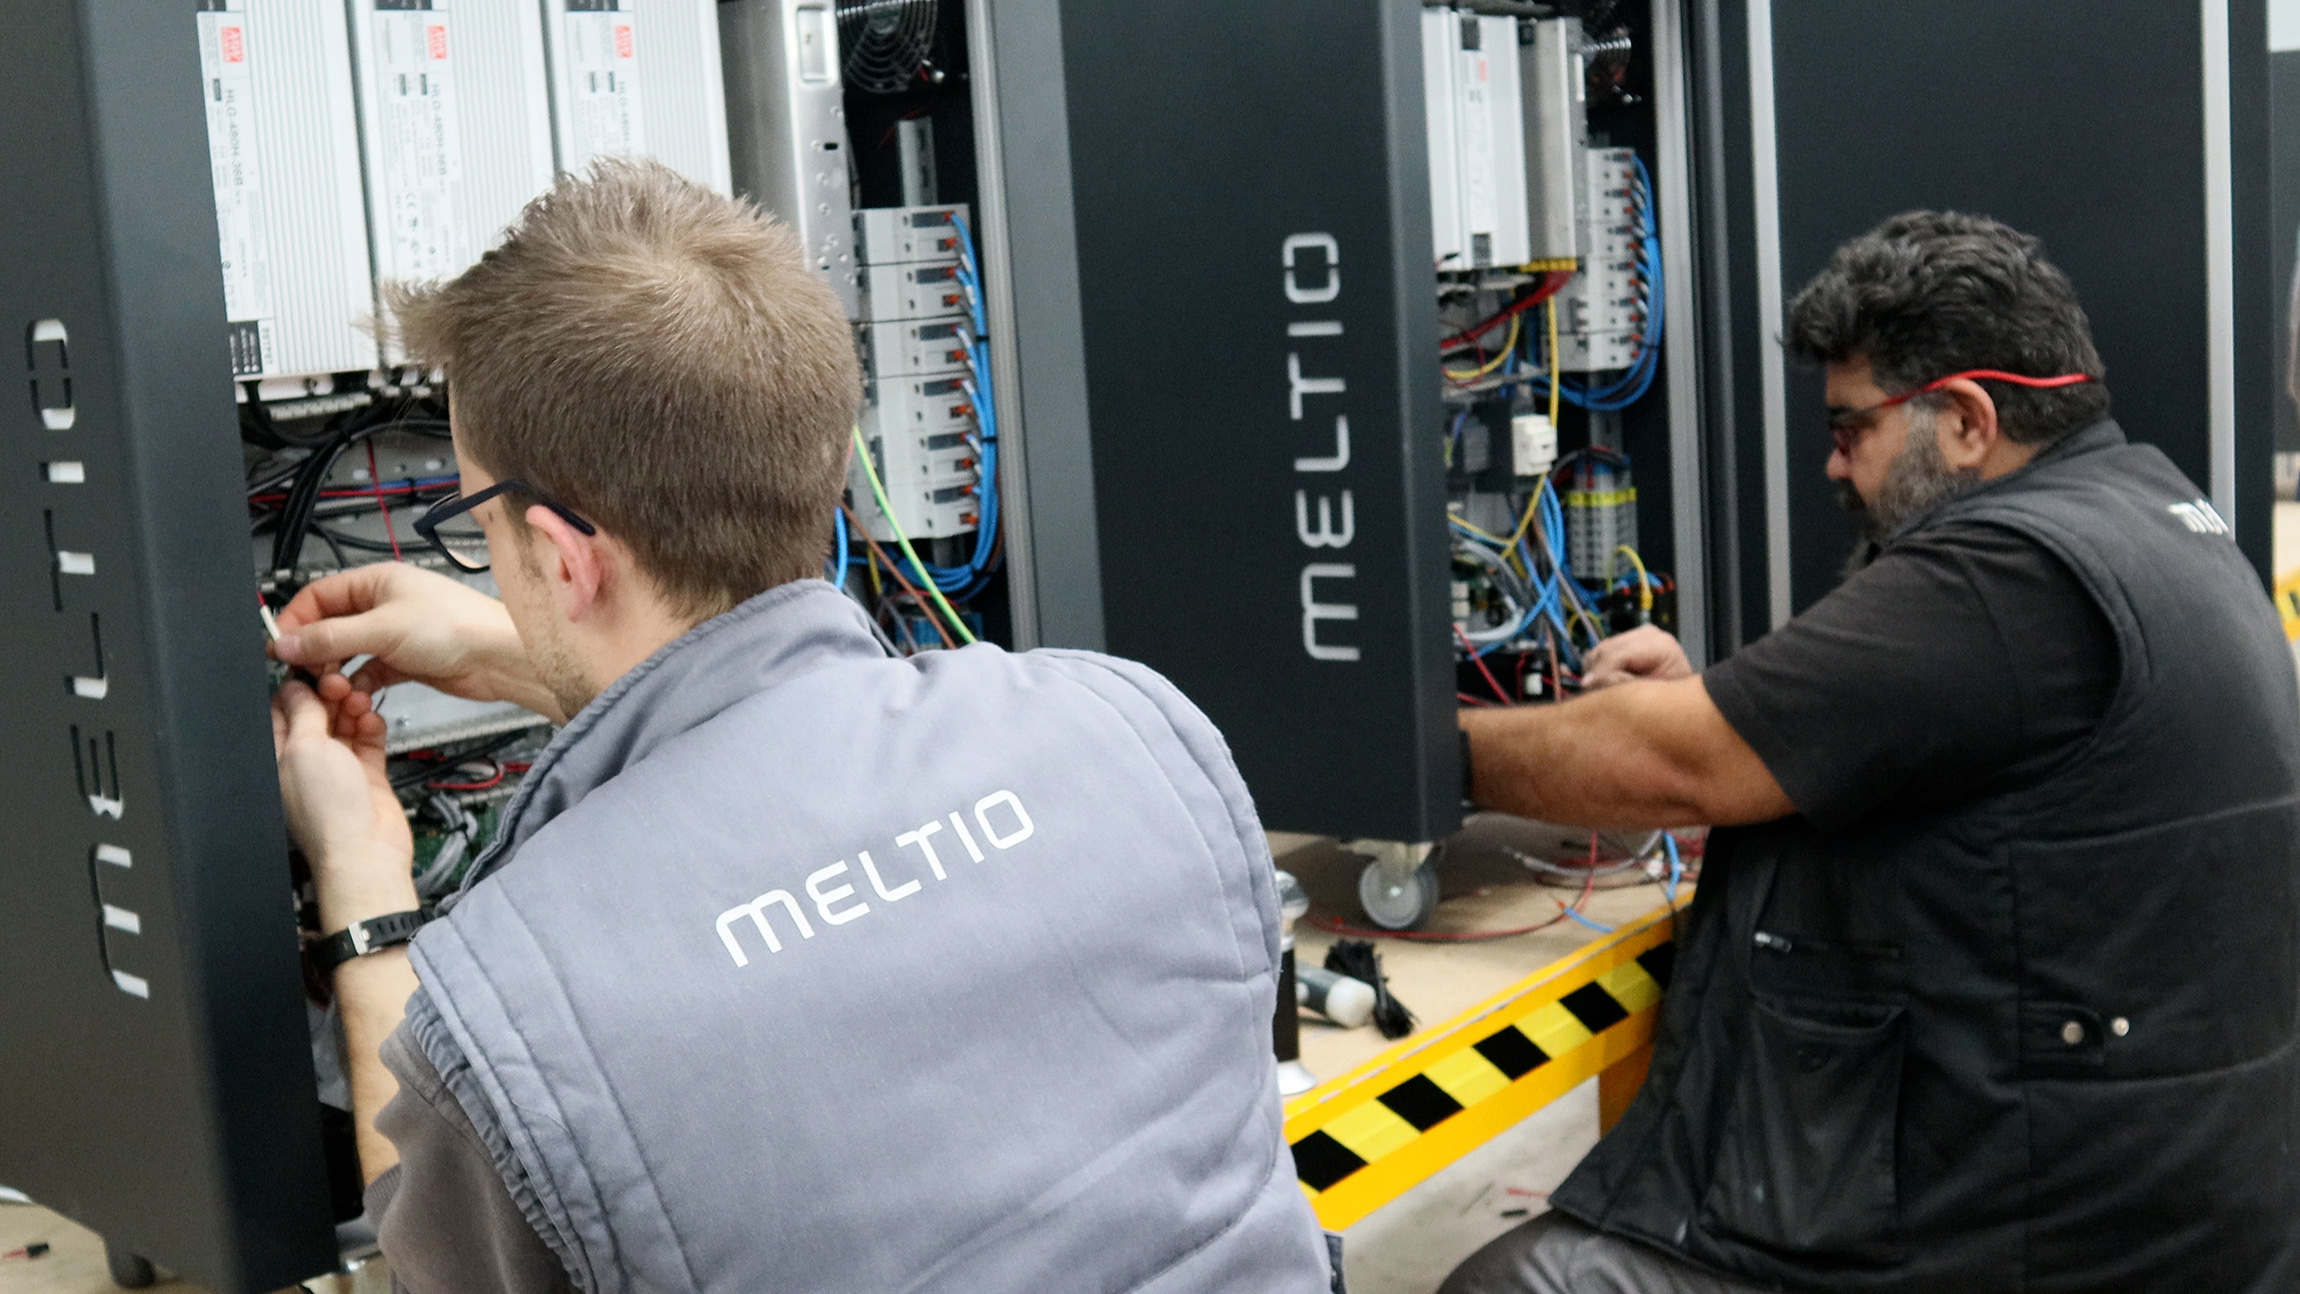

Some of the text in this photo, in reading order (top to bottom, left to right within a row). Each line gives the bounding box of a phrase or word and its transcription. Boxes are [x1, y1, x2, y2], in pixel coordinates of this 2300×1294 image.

[25, 318, 149, 1000] MELTIO
[1281, 230, 1361, 662] MELTIO
[715, 789, 1035, 968] MELTIO
